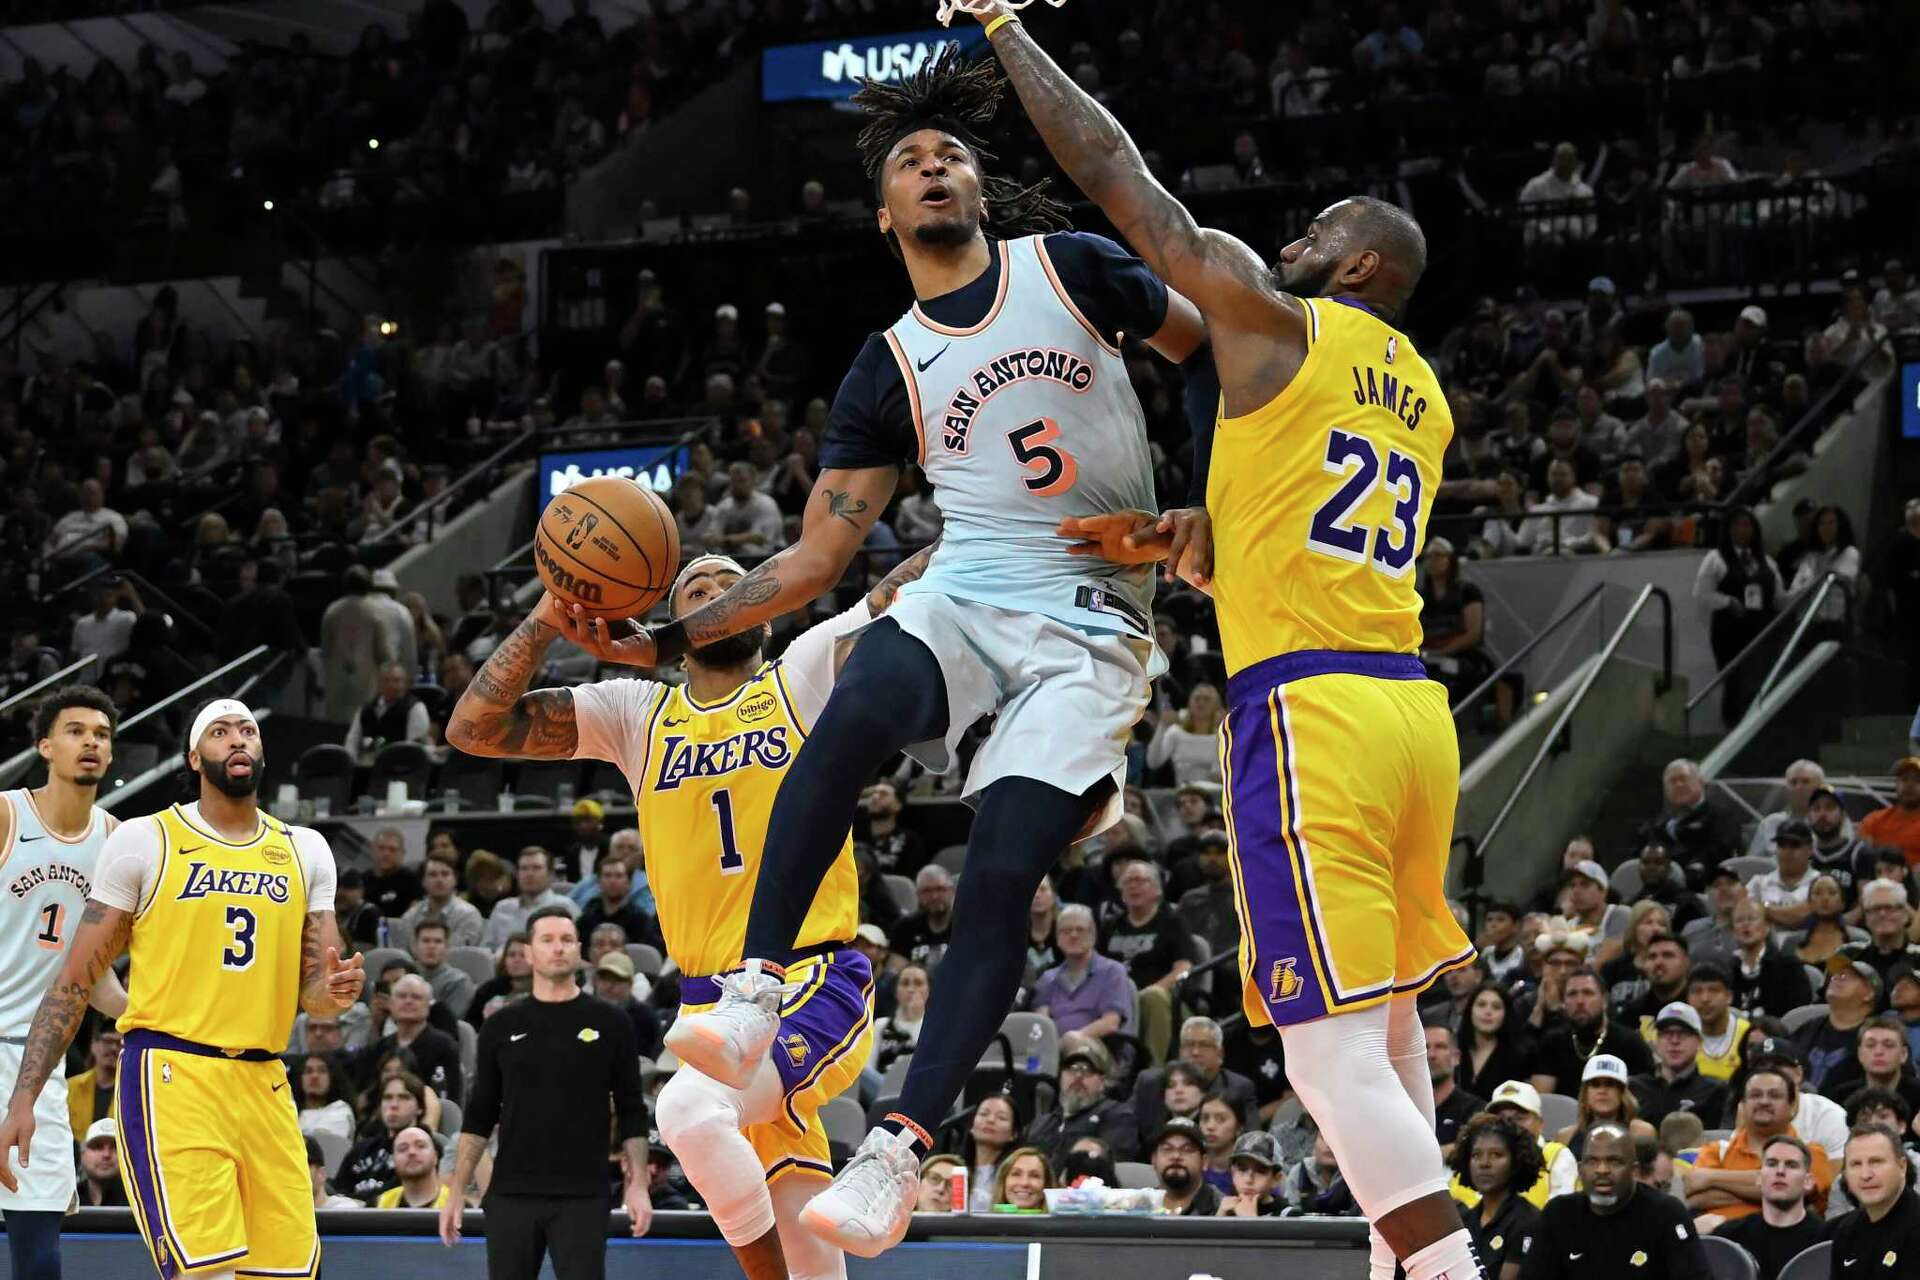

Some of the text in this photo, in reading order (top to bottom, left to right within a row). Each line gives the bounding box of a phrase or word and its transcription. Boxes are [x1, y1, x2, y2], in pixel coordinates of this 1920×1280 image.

[943, 349, 1094, 453] SAN ANTONIO
[1352, 366, 1427, 432] JAMES
[1007, 418, 1072, 494] 5
[1306, 426, 1425, 580] 23
[739, 697, 775, 717] bibigo
[654, 726, 792, 791] LAKERS
[711, 788, 745, 876] 1
[10, 863, 93, 903] SAN ANTON
[176, 862, 290, 903] LAKERS
[37, 902, 65, 949] 1
[221, 904, 258, 974] 3
